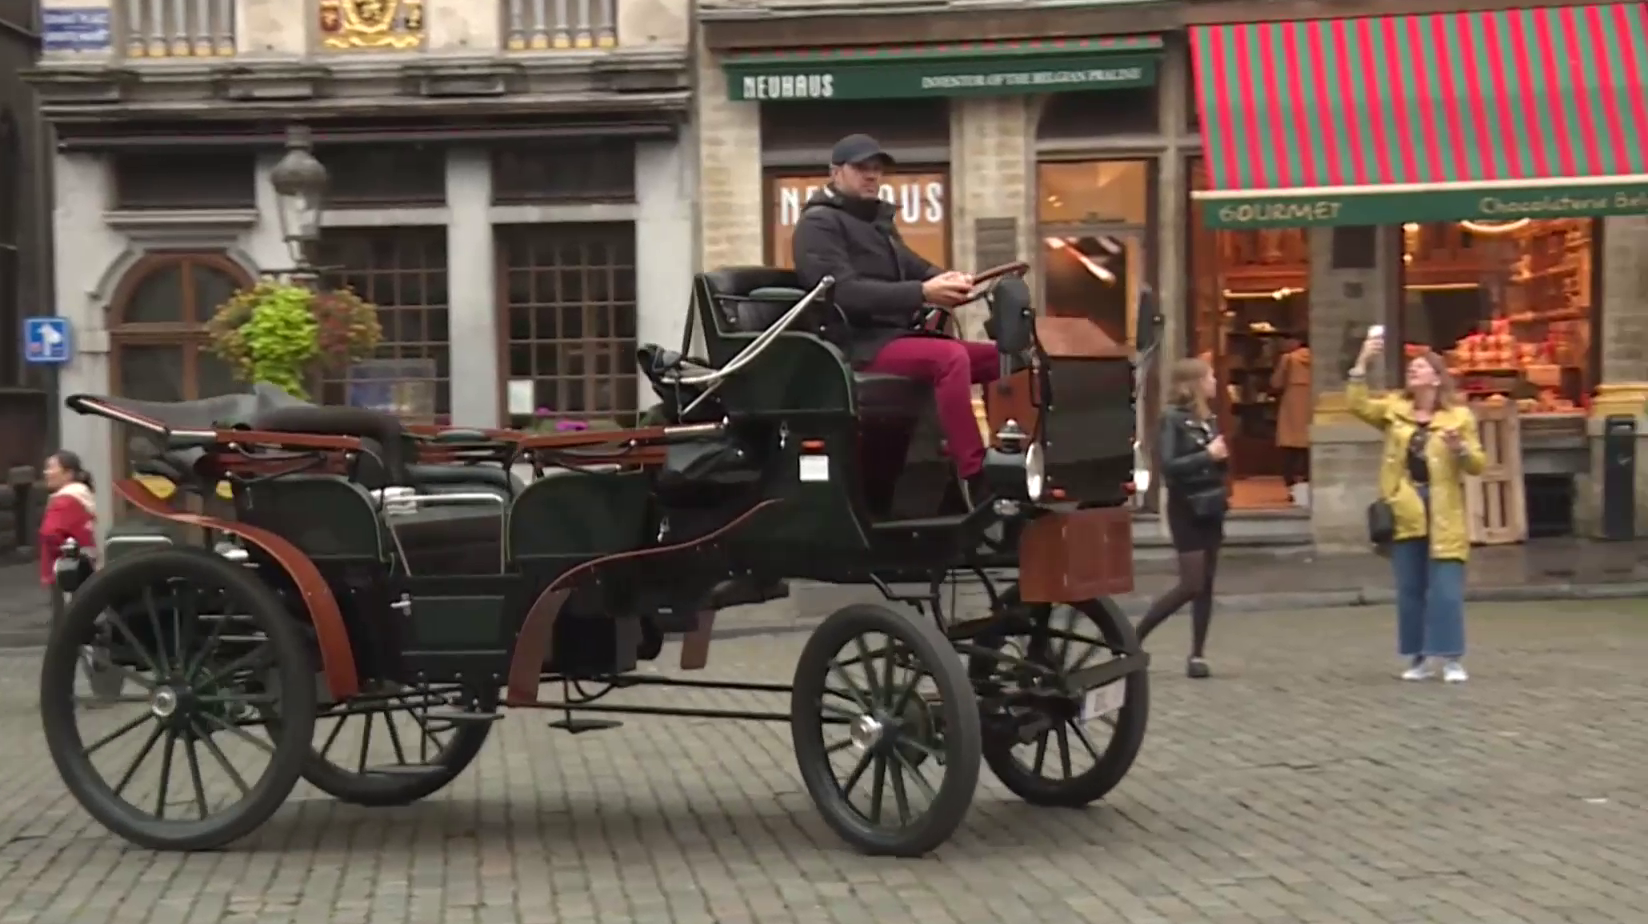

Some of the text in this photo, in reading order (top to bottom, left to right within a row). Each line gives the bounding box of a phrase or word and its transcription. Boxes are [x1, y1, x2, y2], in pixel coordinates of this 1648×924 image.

[743, 73, 834, 99] NEUHAUS
[922, 75, 985, 89] INVENTOR
[987, 74, 1003, 86] OF
[1004, 73, 1030, 86] THE
[1219, 201, 1342, 222] GOURMET
